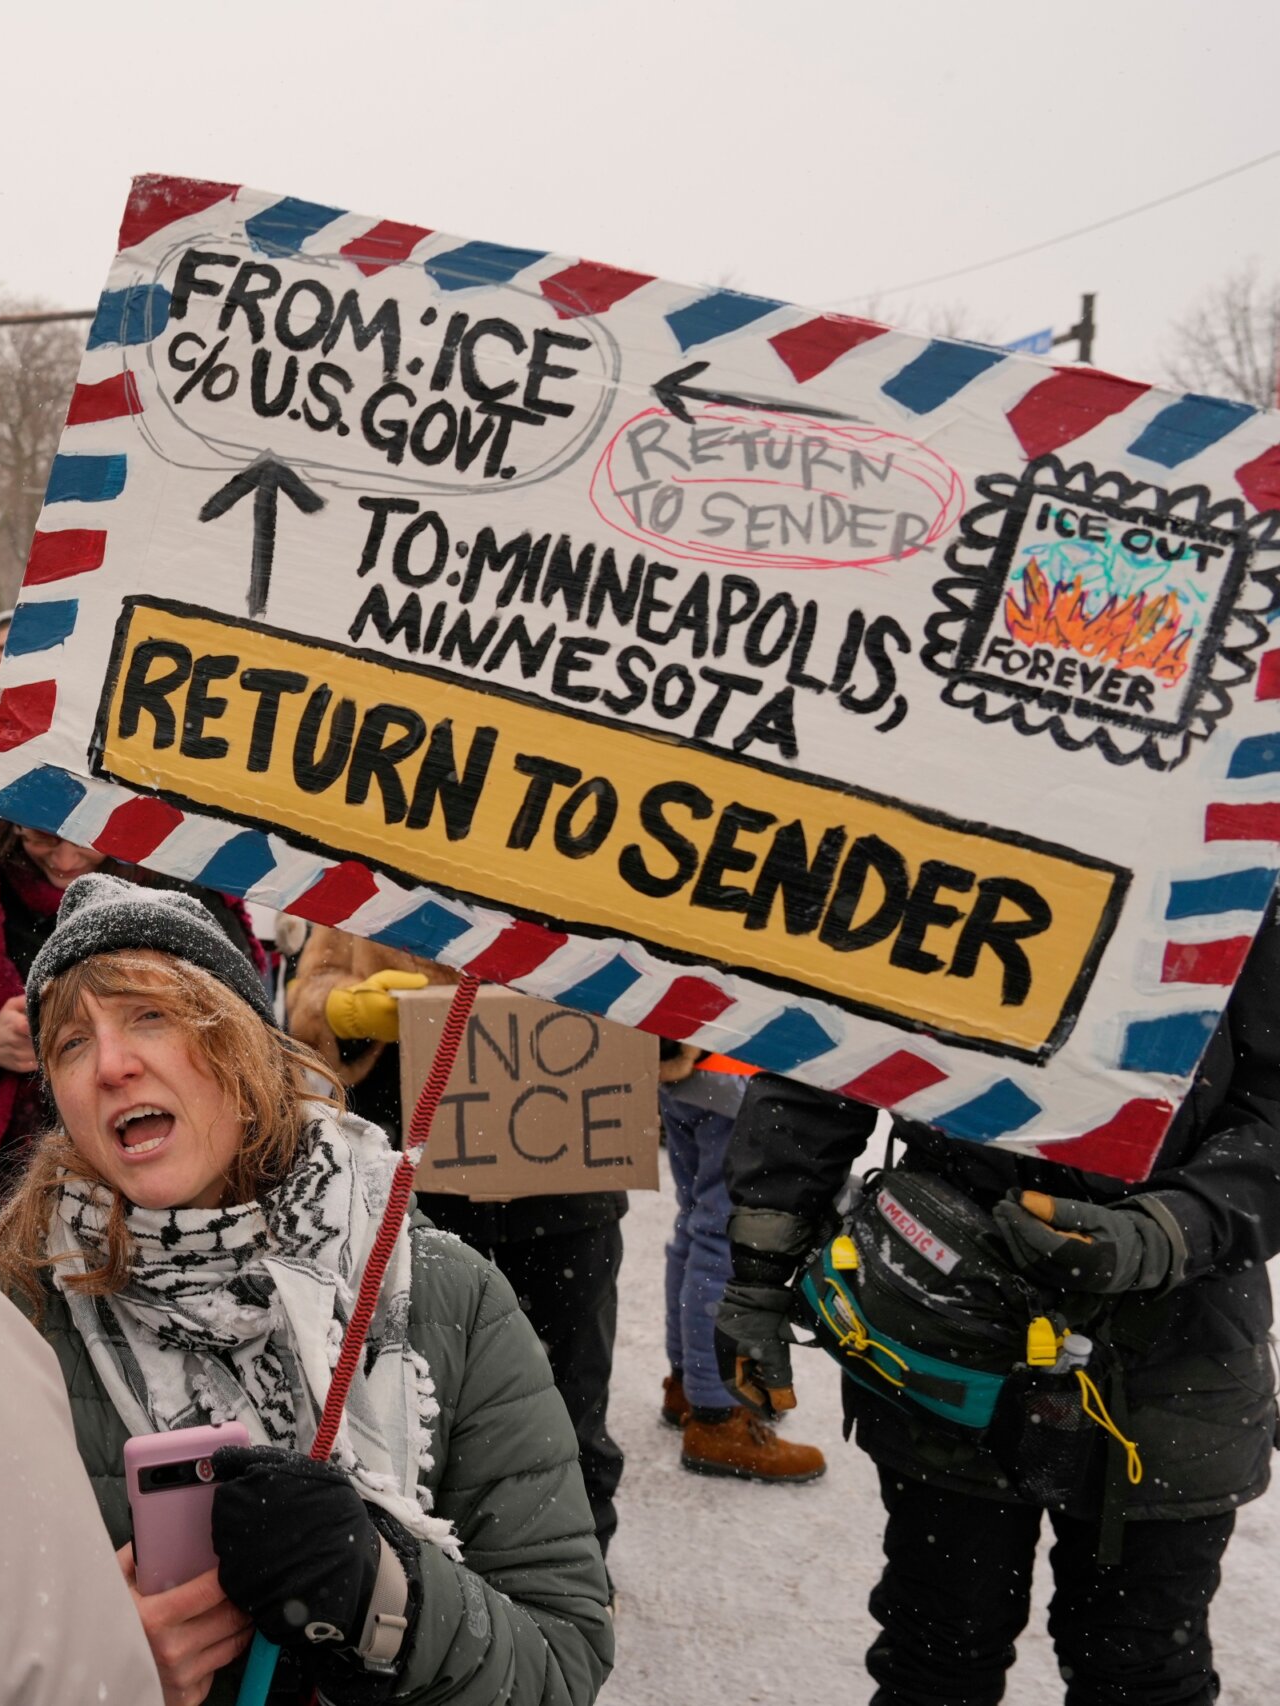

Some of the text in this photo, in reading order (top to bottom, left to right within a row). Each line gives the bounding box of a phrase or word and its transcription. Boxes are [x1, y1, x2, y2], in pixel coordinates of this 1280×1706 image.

[250, 347, 354, 437] U.S.
[626, 419, 897, 490] RETURN
[613, 477, 939, 561] TO SENDER
[1034, 501, 1226, 576] ICE OUT
[348, 584, 800, 760] MINNESOTA
[982, 636, 1158, 715] FOREVER
[118, 637, 500, 843] RETURN
[506, 752, 1054, 1007] TO SENDER
[467, 1009, 600, 1084] NO
[431, 1083, 634, 1169] ICE
[883, 1202, 935, 1253] MEDIC
